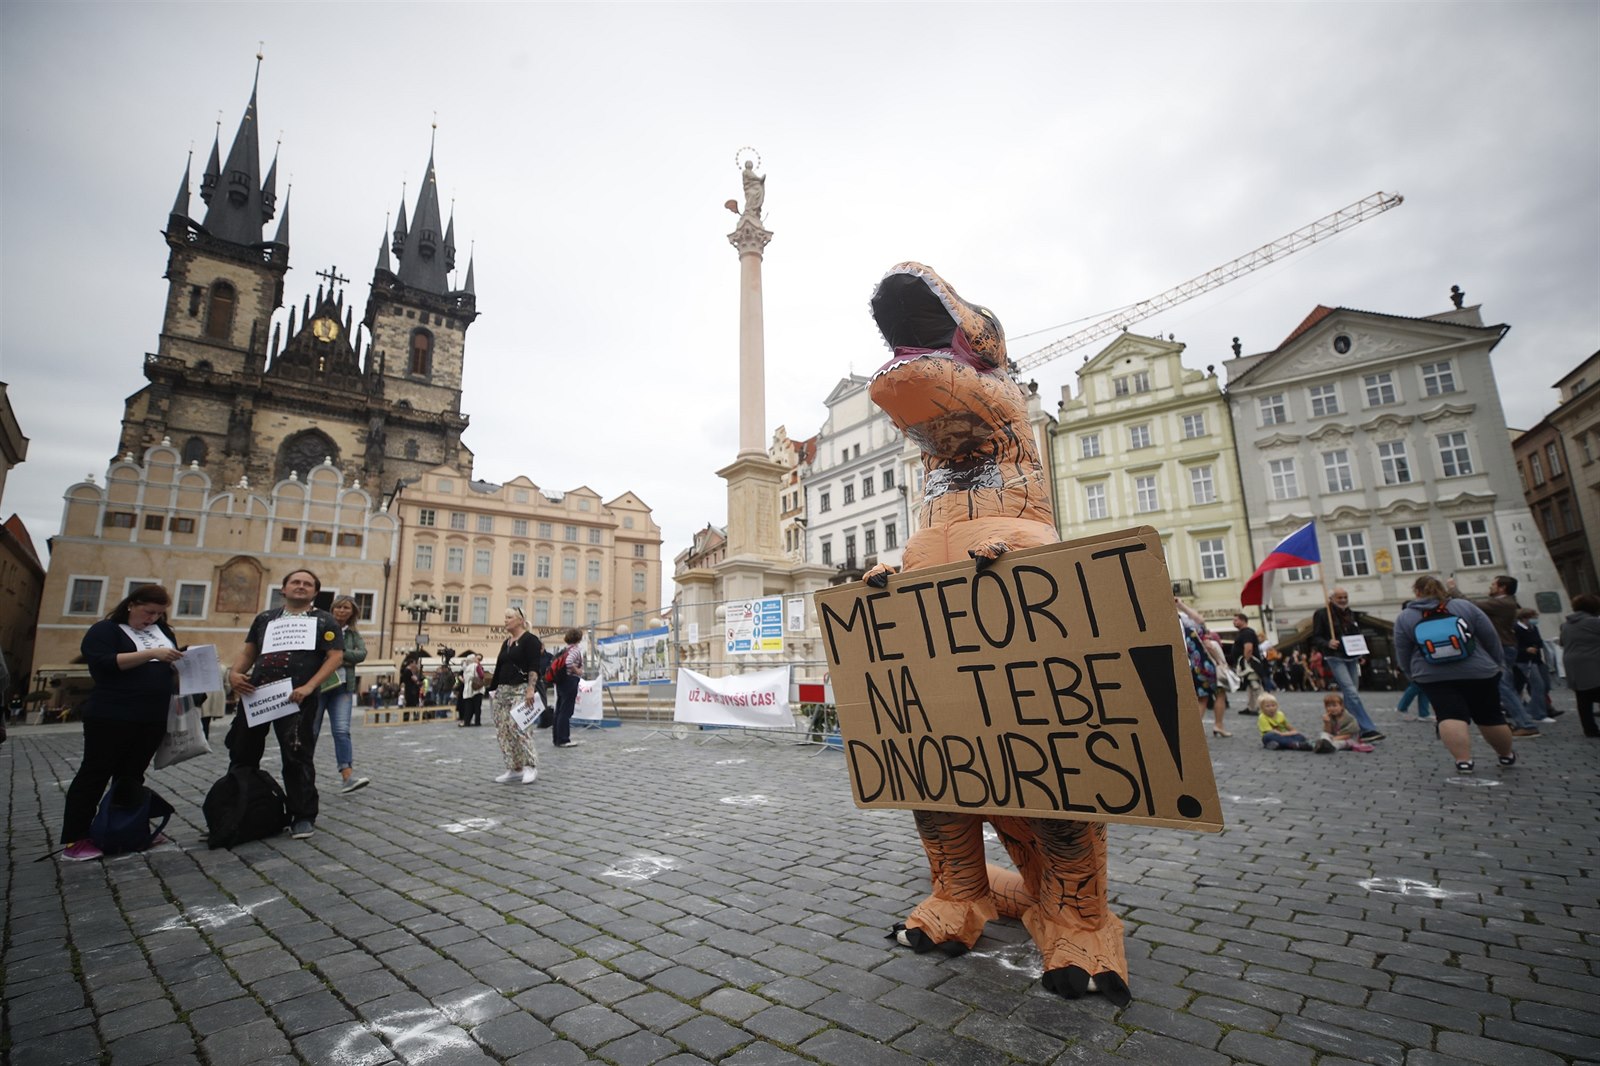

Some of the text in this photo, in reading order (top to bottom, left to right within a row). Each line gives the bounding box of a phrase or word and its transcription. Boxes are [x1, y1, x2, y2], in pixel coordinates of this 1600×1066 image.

[1512, 522, 1537, 583] HOTEL
[821, 543, 1147, 665] METEORIT
[248, 691, 287, 709] NECHCEME
[689, 687, 700, 702] UŽ
[702, 690, 712, 702] JE
[751, 690, 776, 707] ČAS!
[864, 652, 1139, 735] NA TEBE
